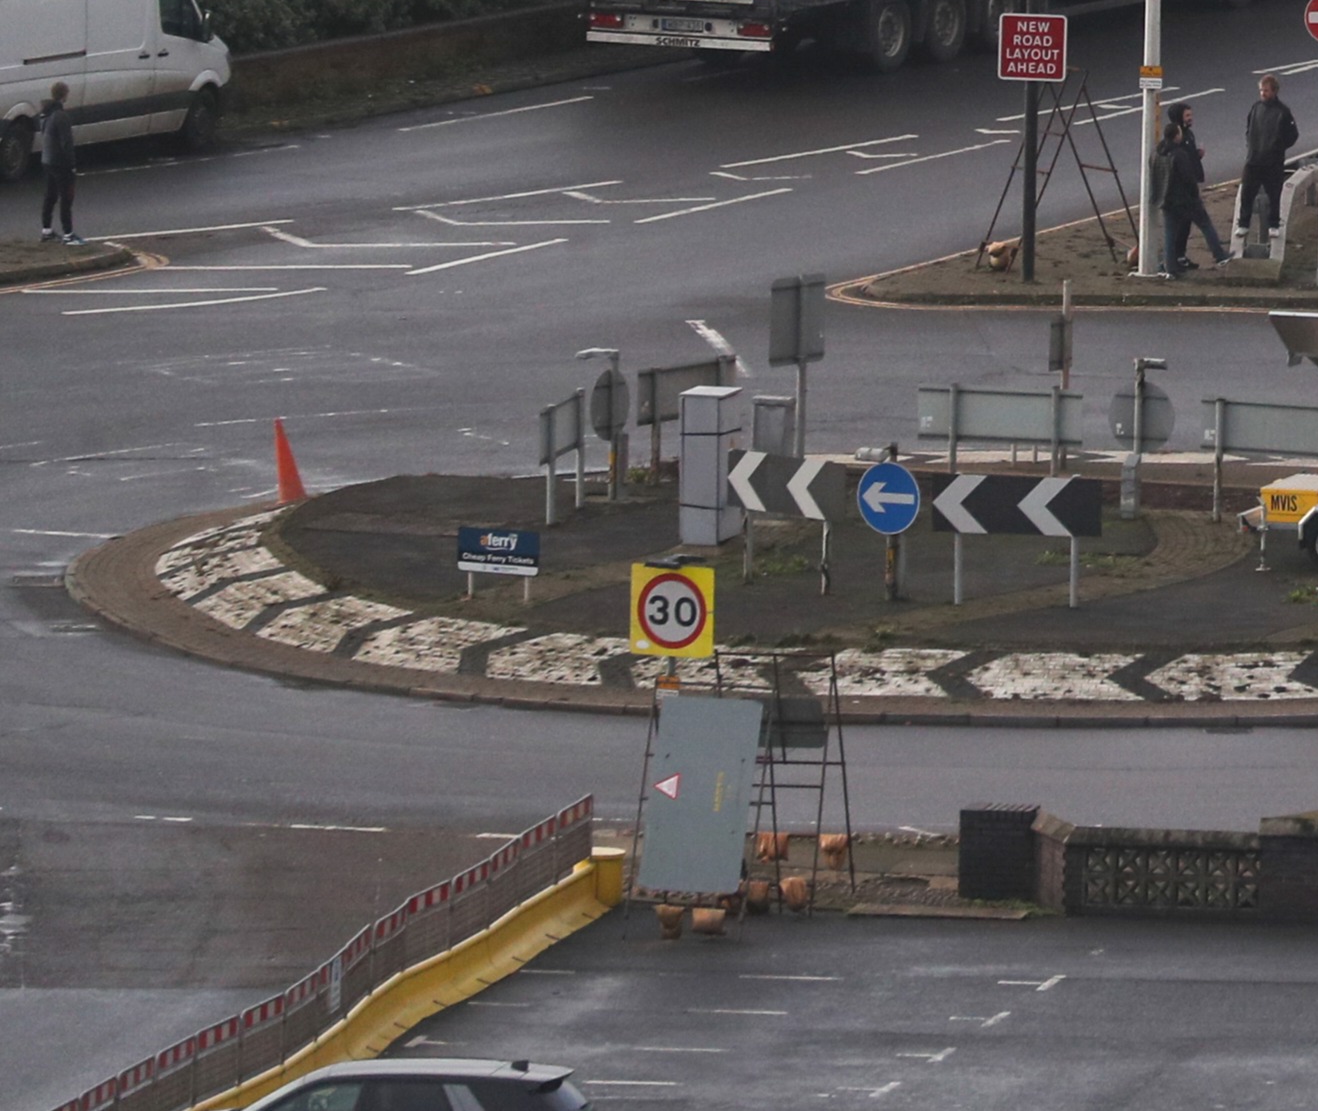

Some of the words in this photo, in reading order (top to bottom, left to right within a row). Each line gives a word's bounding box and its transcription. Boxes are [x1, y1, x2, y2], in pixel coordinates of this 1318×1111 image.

[1017, 21, 1050, 33] NEW
[656, 37, 700, 48] SCHMITZ
[1013, 35, 1053, 47] ROAD
[1006, 49, 1059, 61] LAYOUT
[1007, 62, 1056, 75] AHEAD
[1271, 494, 1297, 512] MVIS
[480, 533, 518, 551] aferry
[462, 553, 486, 562] Cheap
[487, 554, 506, 564] Ferry
[507, 555, 535, 565] Tickets
[648, 595, 697, 627] 30
